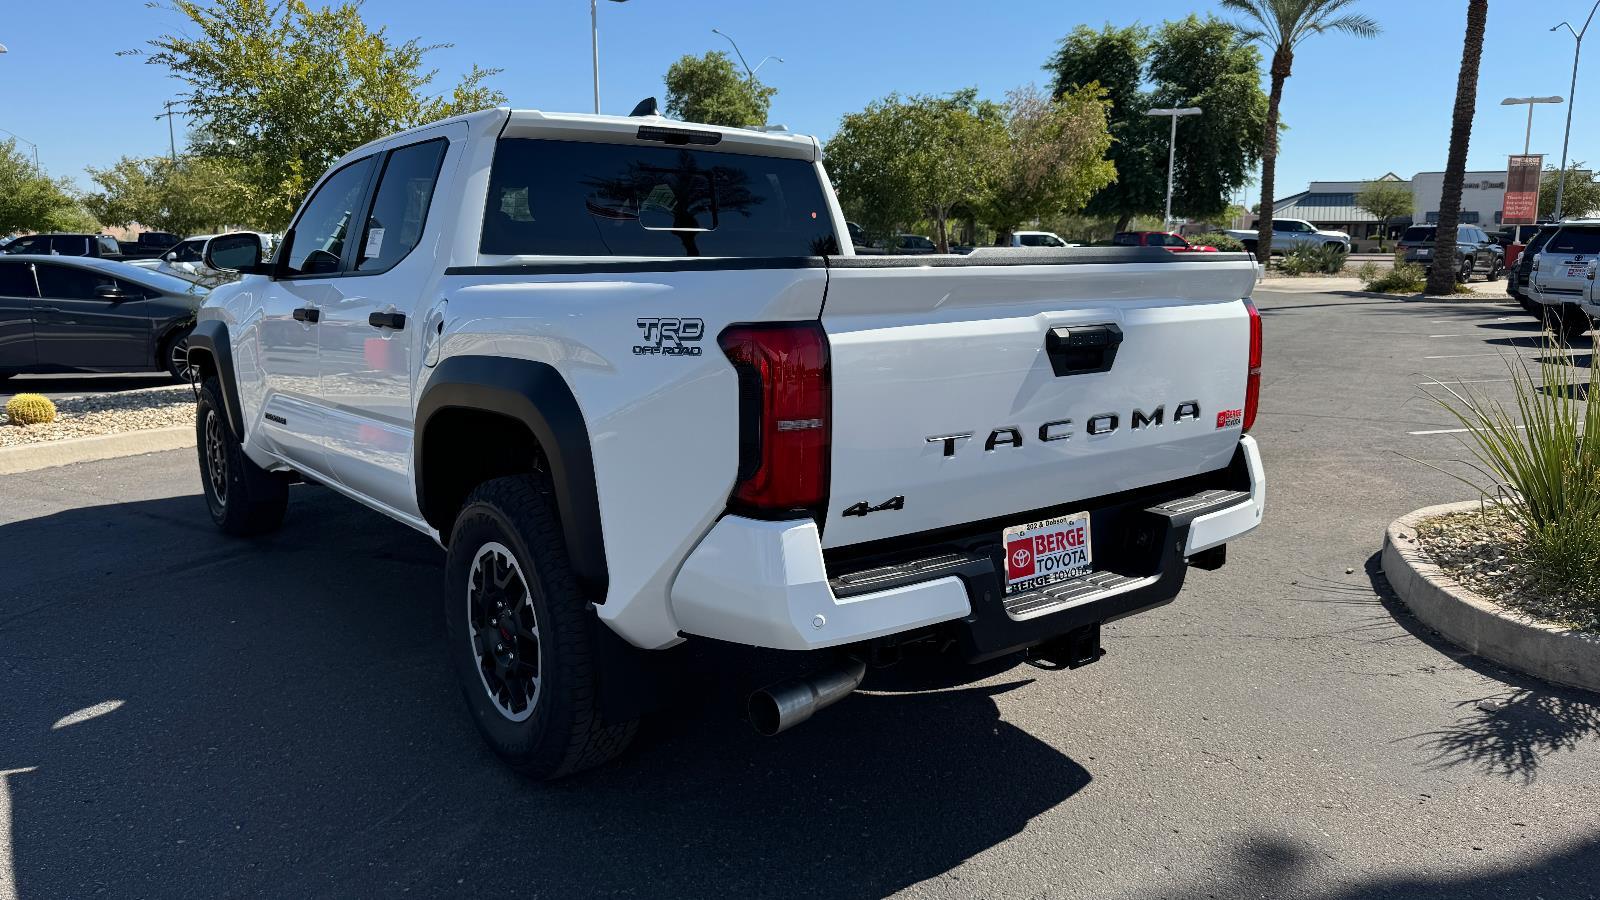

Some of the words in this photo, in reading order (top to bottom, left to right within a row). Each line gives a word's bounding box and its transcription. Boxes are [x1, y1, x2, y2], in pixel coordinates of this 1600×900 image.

[637, 317, 704, 347] TRD
[633, 346, 660, 355] OFF
[662, 346, 702, 356] ROAD
[925, 400, 1201, 459] TACOMA
[1035, 527, 1084, 555] BERGE
[1036, 549, 1086, 572] TOYOTA
[1011, 574, 1051, 592] BERGE
[1053, 566, 1089, 580] TOYOTA
